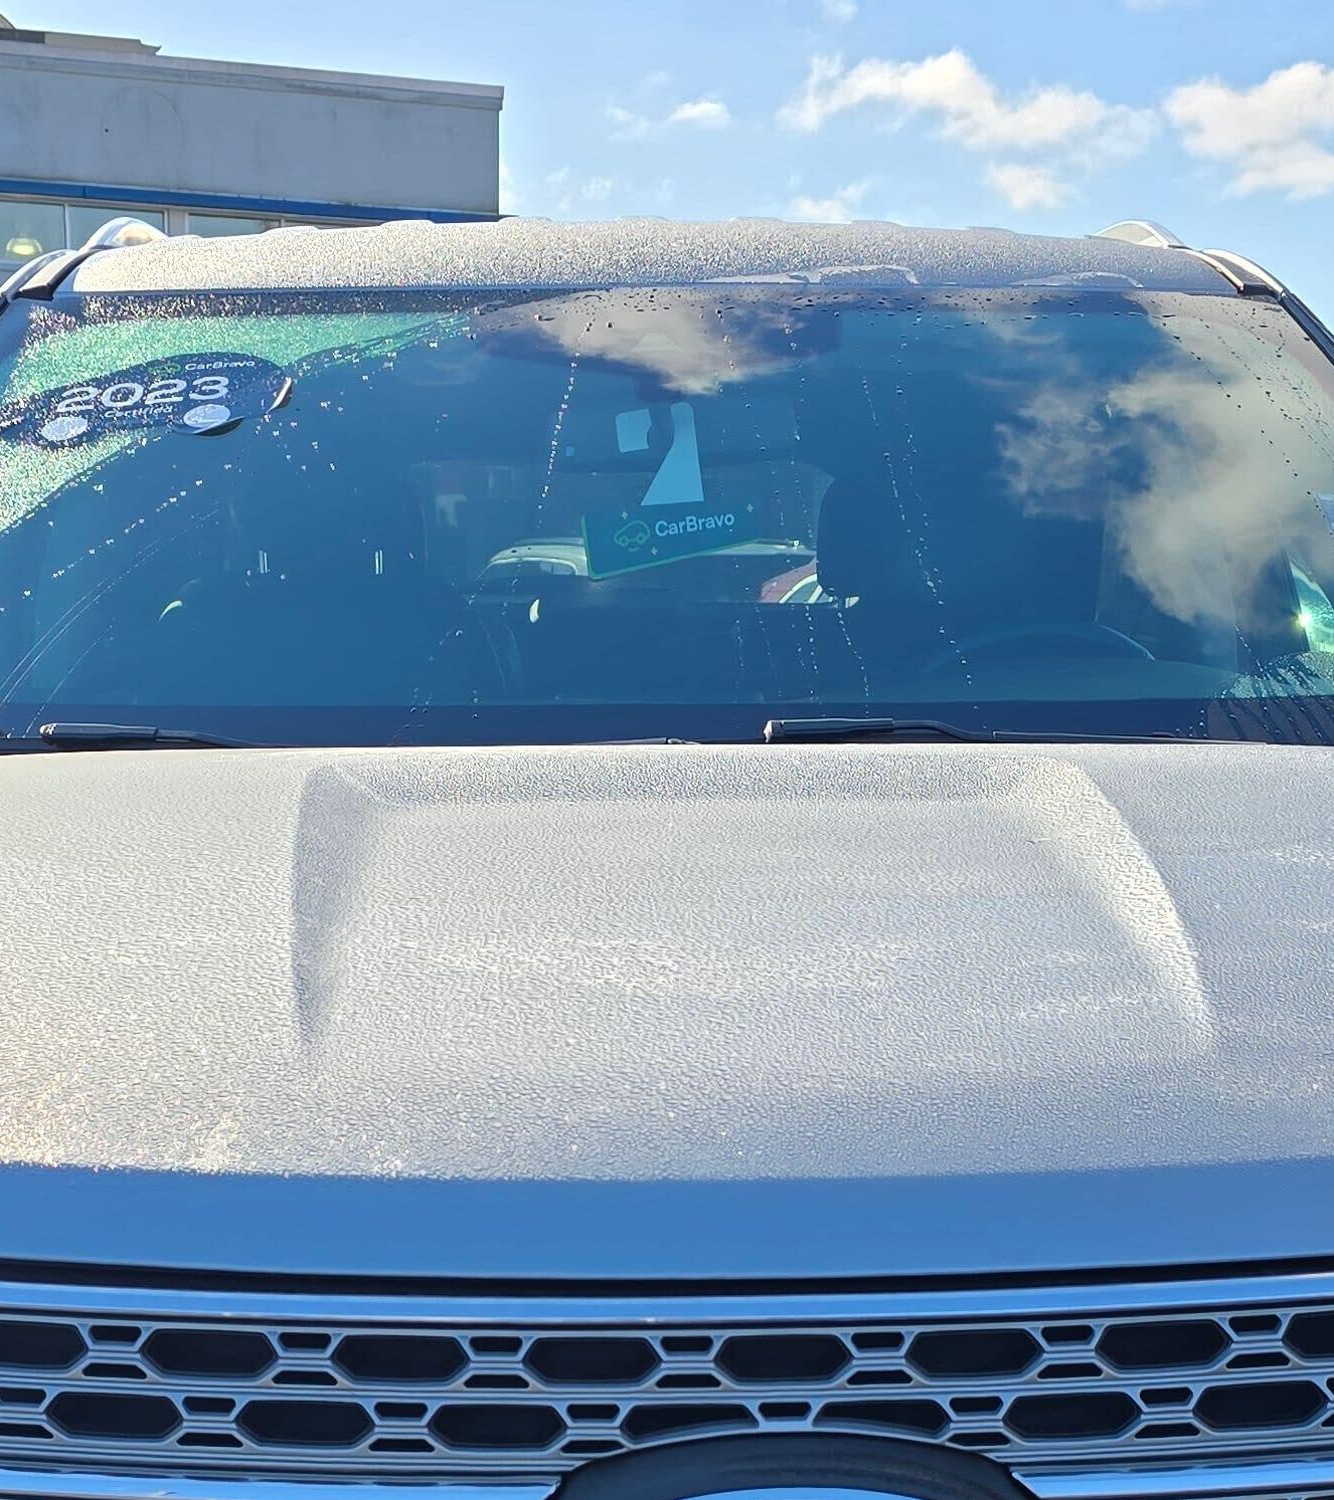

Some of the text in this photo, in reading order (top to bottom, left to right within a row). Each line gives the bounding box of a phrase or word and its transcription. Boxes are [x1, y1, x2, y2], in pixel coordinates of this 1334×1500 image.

[184, 360, 256, 372] CarBravo
[56, 375, 229, 413] 2023
[654, 512, 735, 537] CarBravo
